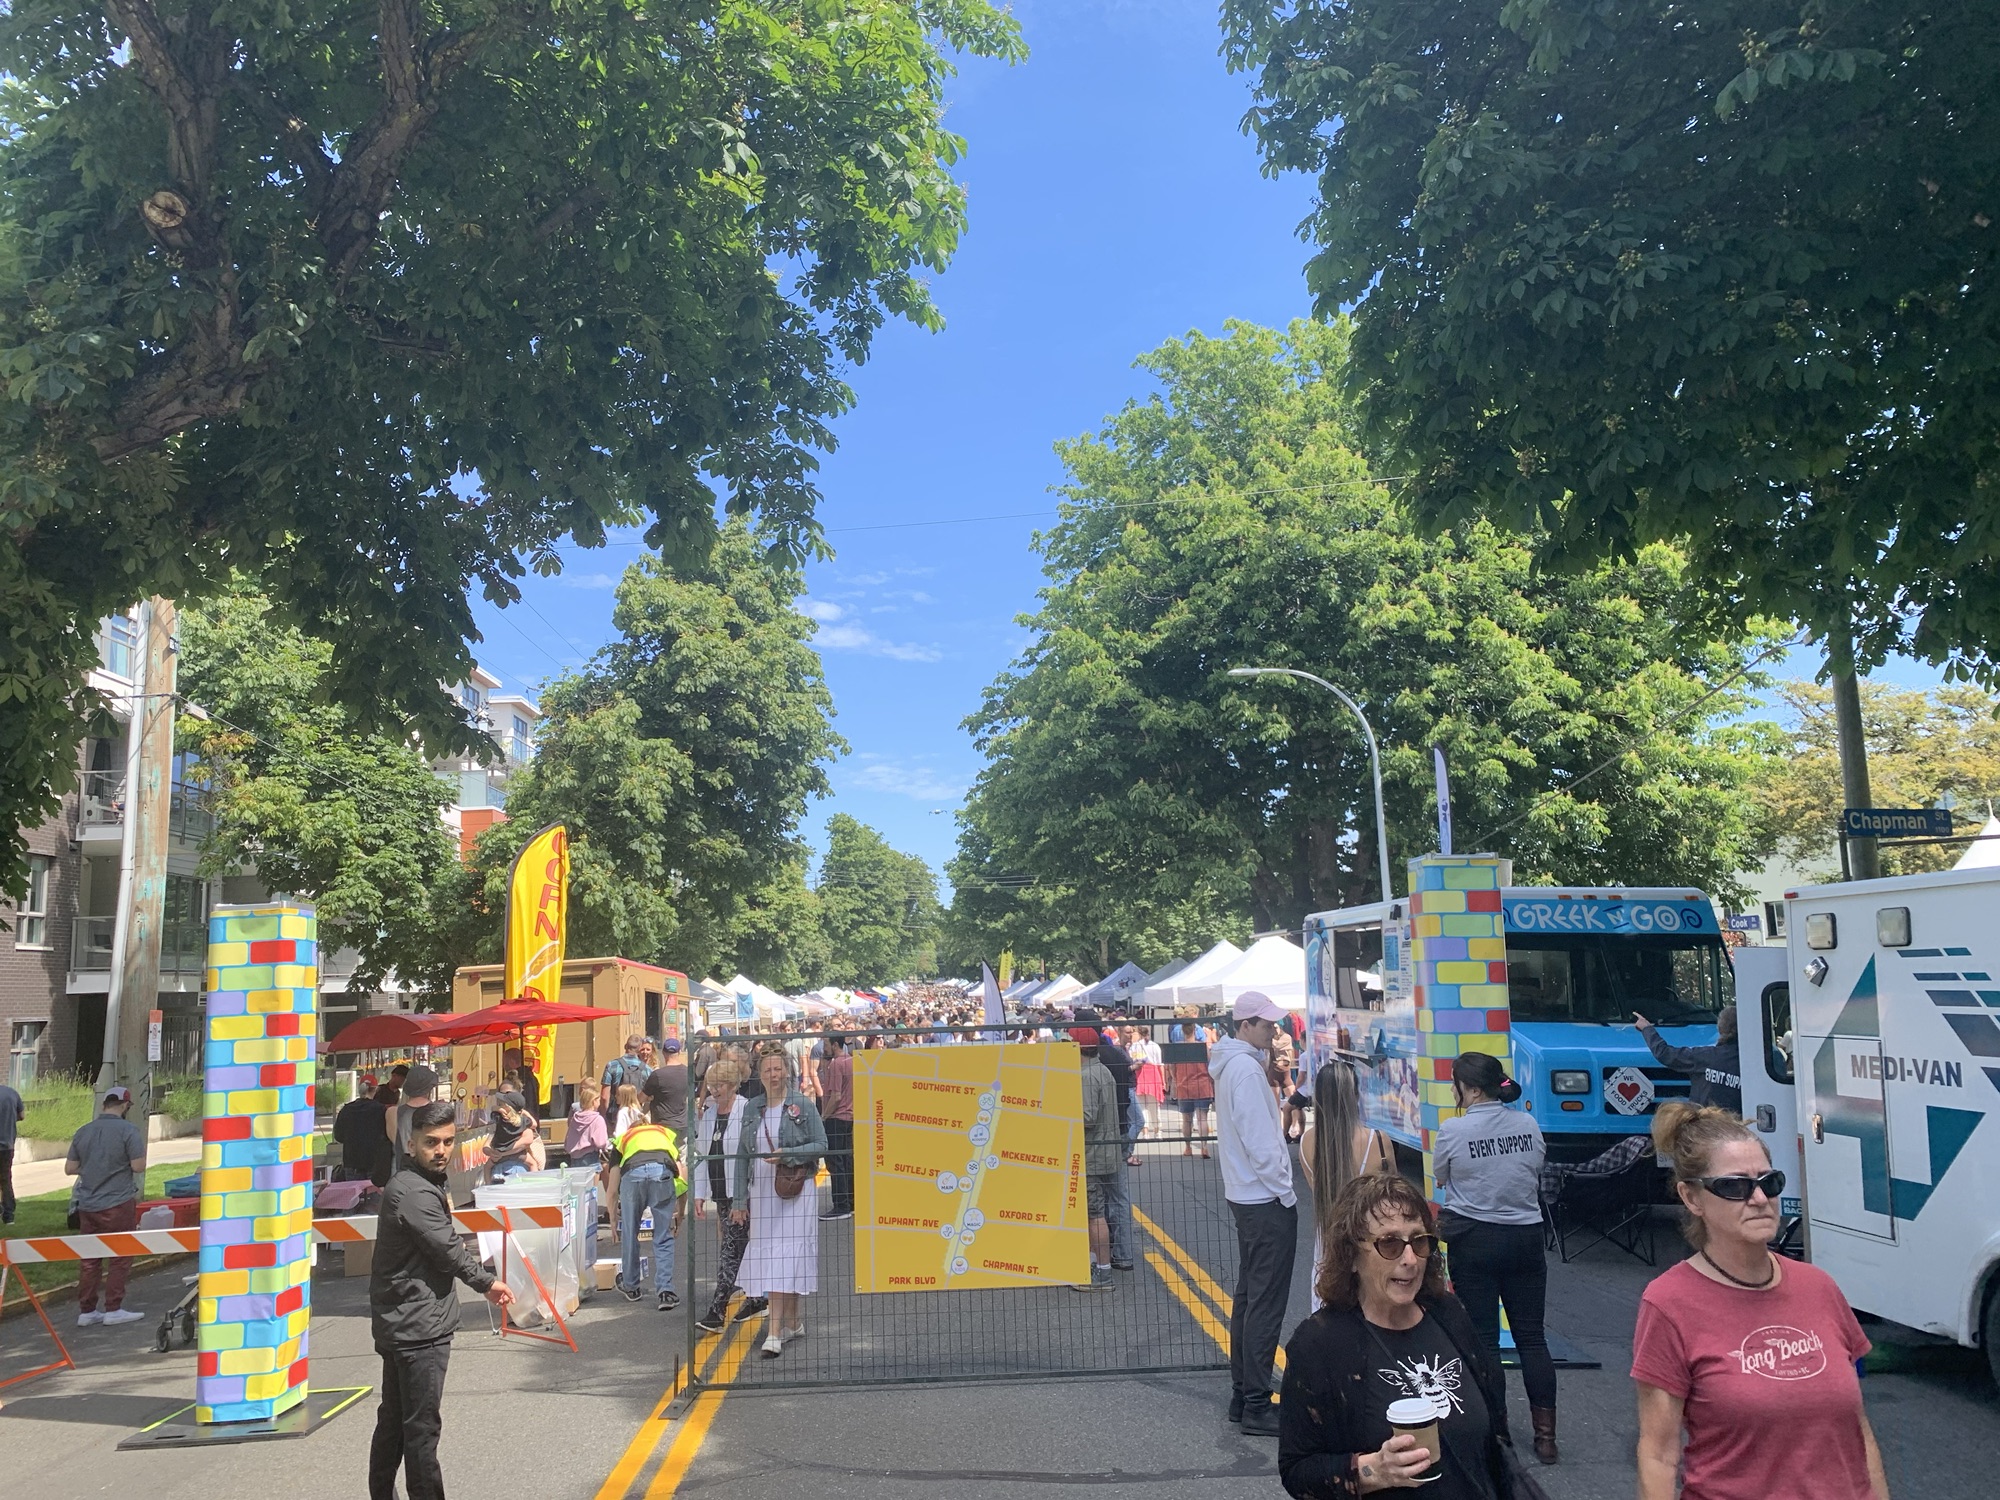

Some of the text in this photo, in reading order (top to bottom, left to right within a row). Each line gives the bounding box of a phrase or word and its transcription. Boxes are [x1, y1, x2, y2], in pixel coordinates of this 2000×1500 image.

[1849, 811, 1927, 834] Chapman
[534, 831, 568, 941] CORN
[1513, 903, 1605, 930] GREEK
[1630, 905, 1681, 931] GO
[1730, 918, 1748, 928] Cook
[1705, 1068, 1726, 1085] EVENT
[1851, 1054, 1963, 1088] MEDI-VAN
[911, 1081, 976, 1096] SOUTHGATE ST.
[1000, 1095, 1043, 1109] OSCAR ST.
[1610, 1090, 1627, 1106] FOOD
[1627, 1090, 1648, 1111] TRUCKS
[893, 1112, 963, 1129] PENDERGAST ST.
[875, 1099, 884, 1168] VANCOUVER ST.
[1468, 1133, 1534, 1159] EVENT SUPPORT
[1001, 1150, 1059, 1167] MCKENZIE ST.
[894, 1163, 927, 1176] SUTLEJ
[1067, 1153, 1081, 1209] CHESTER ST.
[878, 1216, 940, 1228] OLIPHANT AVE
[999, 1209, 1048, 1223] OXFORD ST.
[982, 1259, 1040, 1275] CHAPMAN ST.
[888, 1276, 936, 1285] PARK BLVD
[1738, 1329, 1824, 1374] Long Beach
